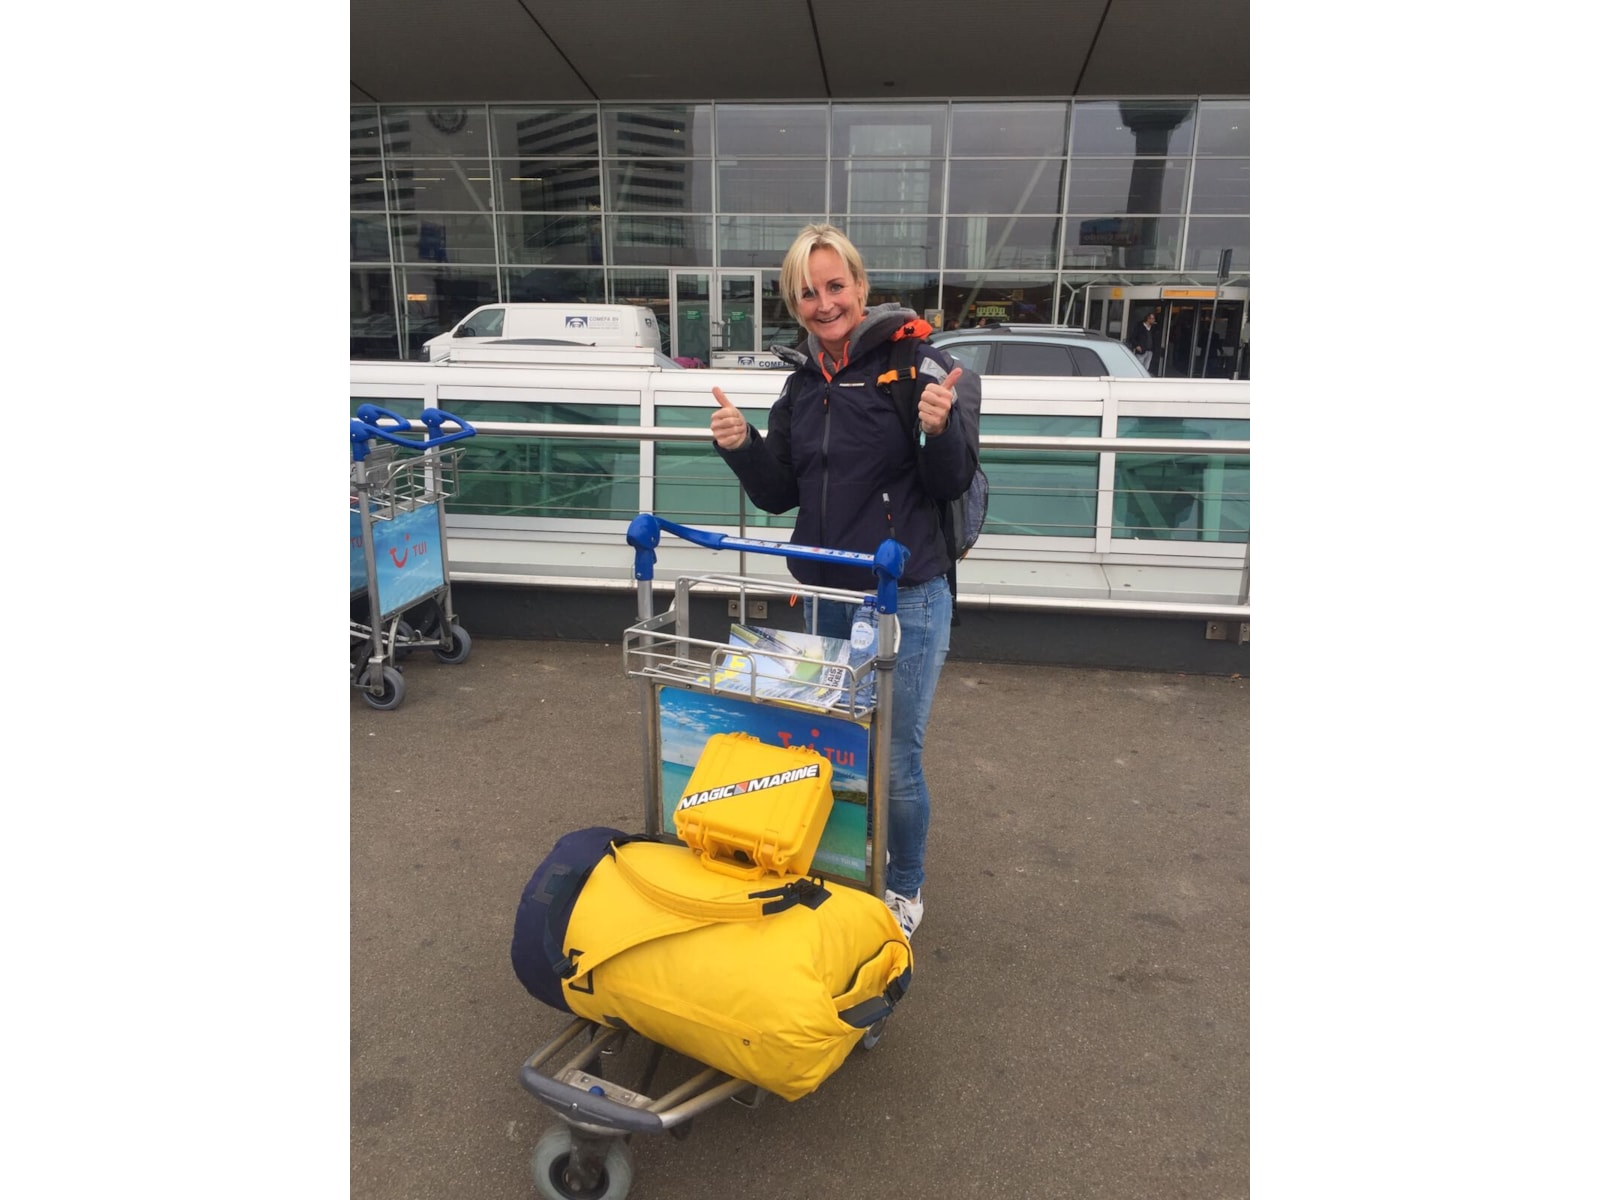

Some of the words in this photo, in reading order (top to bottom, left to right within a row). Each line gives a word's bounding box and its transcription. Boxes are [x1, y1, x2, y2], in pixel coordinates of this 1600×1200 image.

[412, 540, 428, 558] TUI
[823, 746, 855, 767] TUI
[678, 784, 736, 811] MAGIC
[747, 764, 819, 793] MARINE
